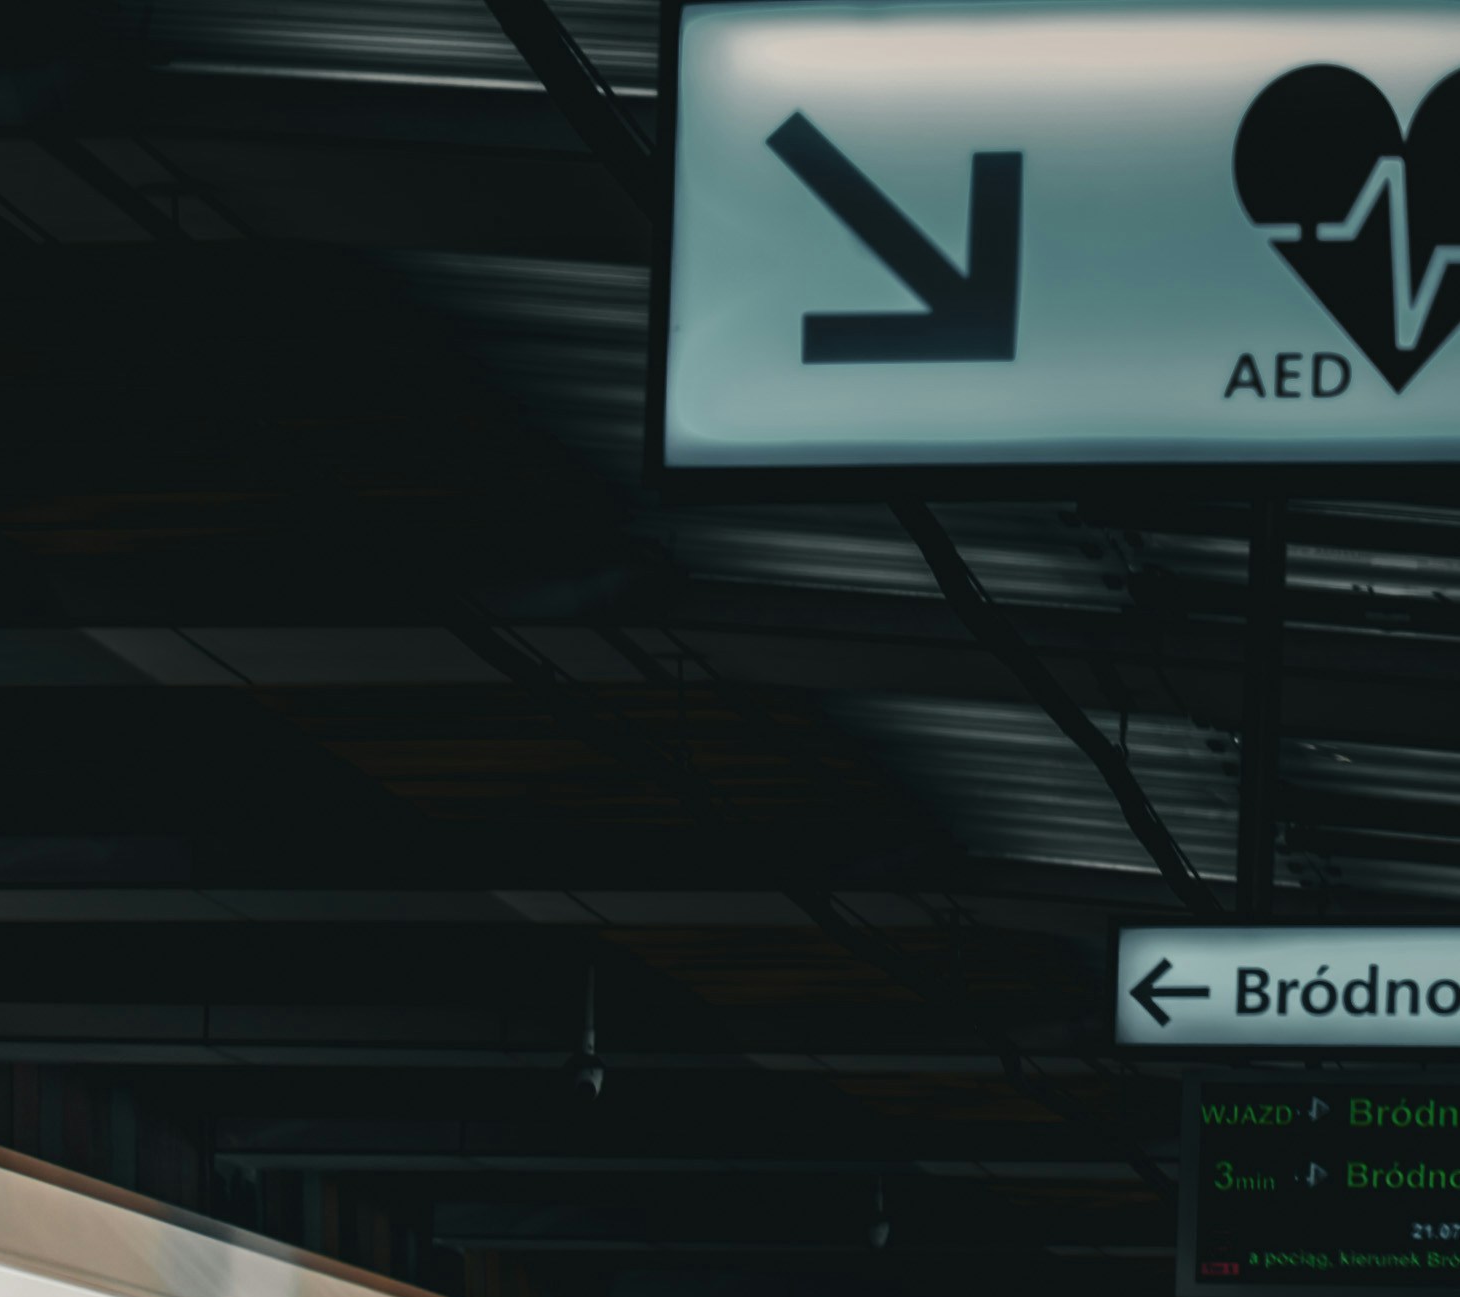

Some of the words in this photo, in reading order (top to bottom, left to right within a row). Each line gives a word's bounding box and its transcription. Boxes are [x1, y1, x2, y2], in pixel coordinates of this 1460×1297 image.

[1224, 351, 1352, 399] AED
[1236, 962, 1460, 1017] Bródno
[1201, 1103, 1294, 1126] WJAZD
